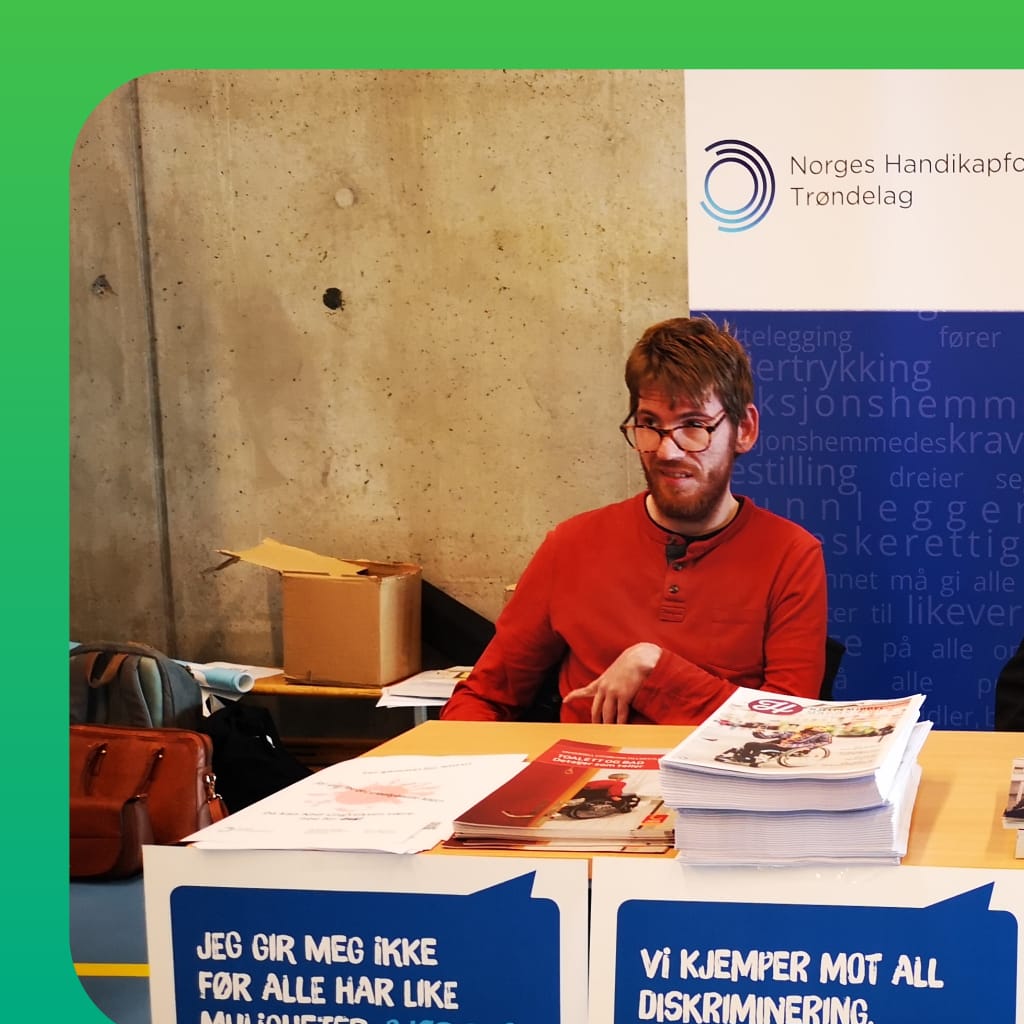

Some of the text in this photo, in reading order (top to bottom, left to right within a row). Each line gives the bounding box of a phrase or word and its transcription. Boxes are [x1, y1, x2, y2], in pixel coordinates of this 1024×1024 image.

[790, 156, 875, 177] Norges
[791, 186, 914, 209] Trøndelag
[738, 325, 852, 352] telegging
[939, 325, 1001, 348] fører
[757, 352, 932, 392] ertrykking
[949, 422, 1024, 454] krav
[731, 456, 858, 495] estilling
[889, 465, 964, 489] dreier
[890, 568, 1016, 597] må gi alle
[872, 603, 892, 623] til
[883, 635, 974, 663] på alle
[892, 672, 933, 691] alle
[197, 930, 242, 961] JEG
[252, 933, 296, 964] GIR
[304, 934, 365, 966] MEG
[680, 948, 811, 983] KJEMPER
[820, 952, 883, 984] MOT
[892, 956, 944, 989] ALL
[198, 970, 459, 1010] FØR ALLE HAR LIKE
